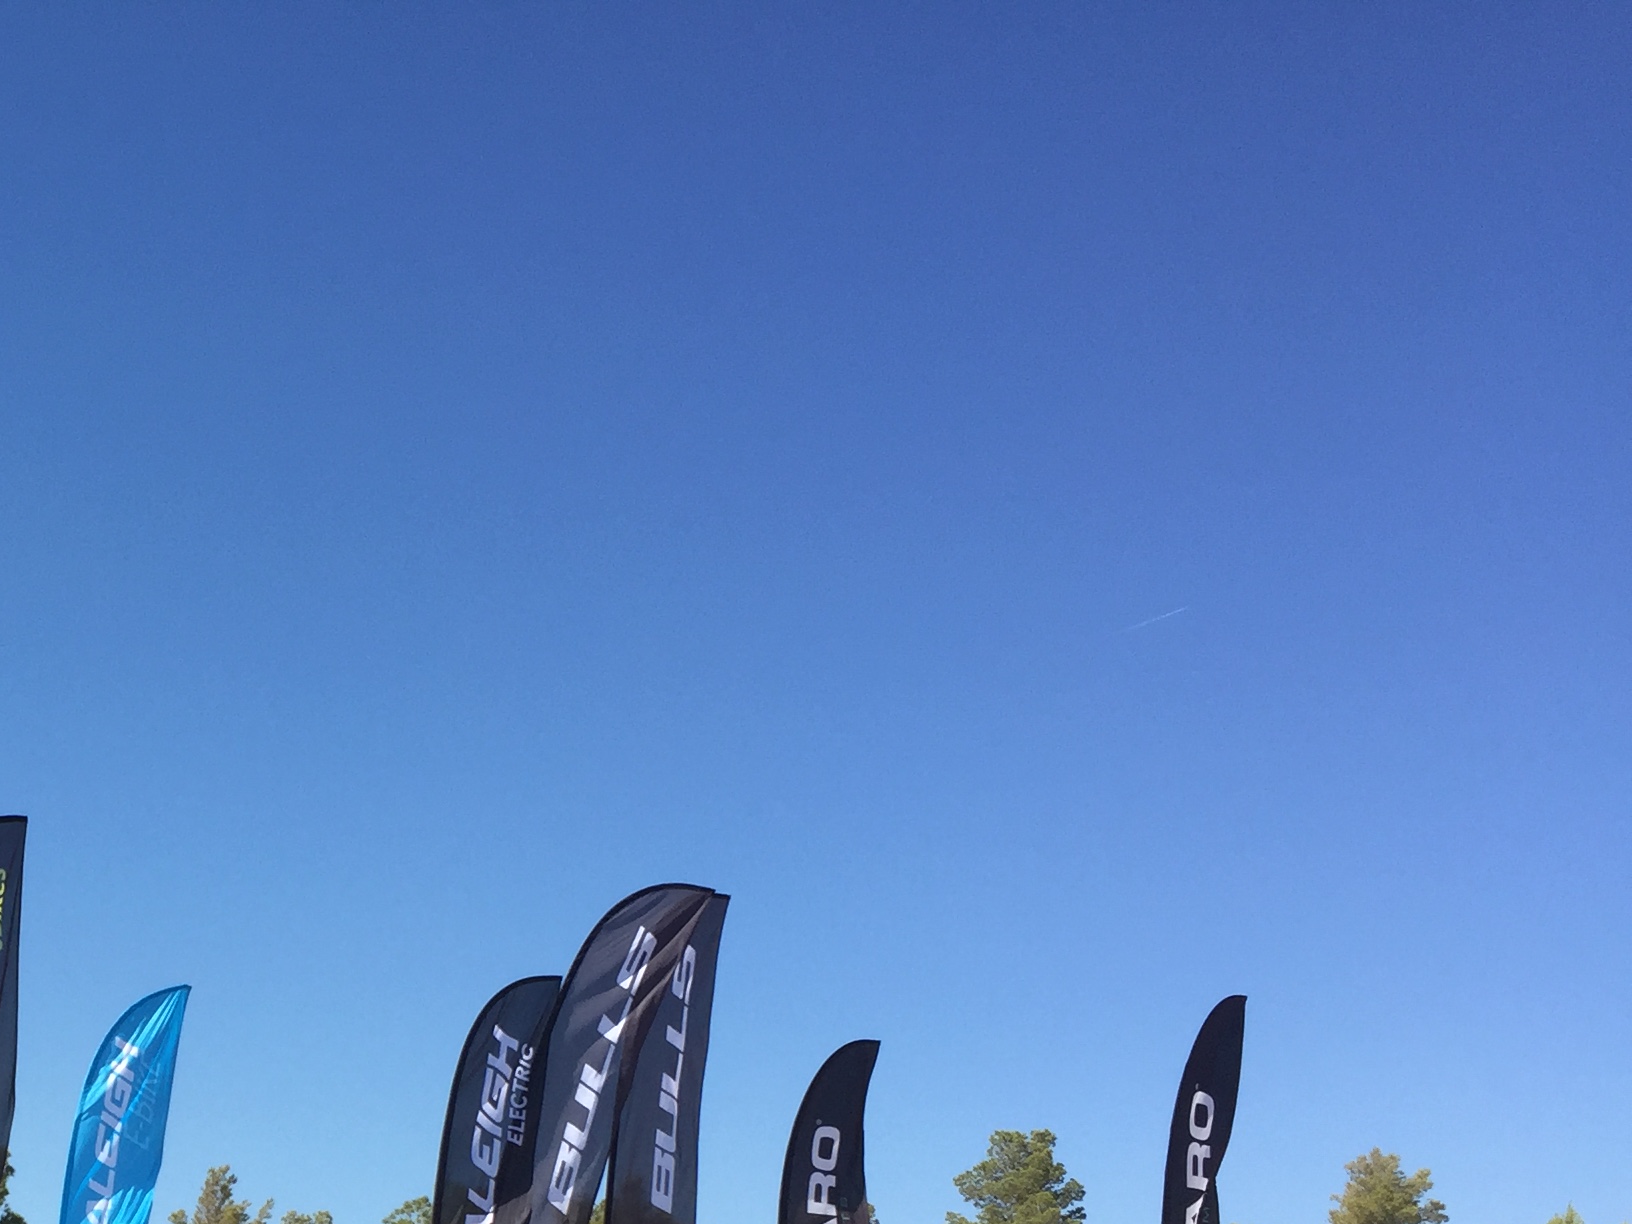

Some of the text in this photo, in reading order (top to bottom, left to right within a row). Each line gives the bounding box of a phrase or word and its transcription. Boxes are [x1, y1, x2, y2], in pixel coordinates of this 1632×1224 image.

[506, 1042, 535, 1148] ELECTRIC
[548, 925, 657, 1216] BULLS
[650, 944, 697, 1215] BULLS
